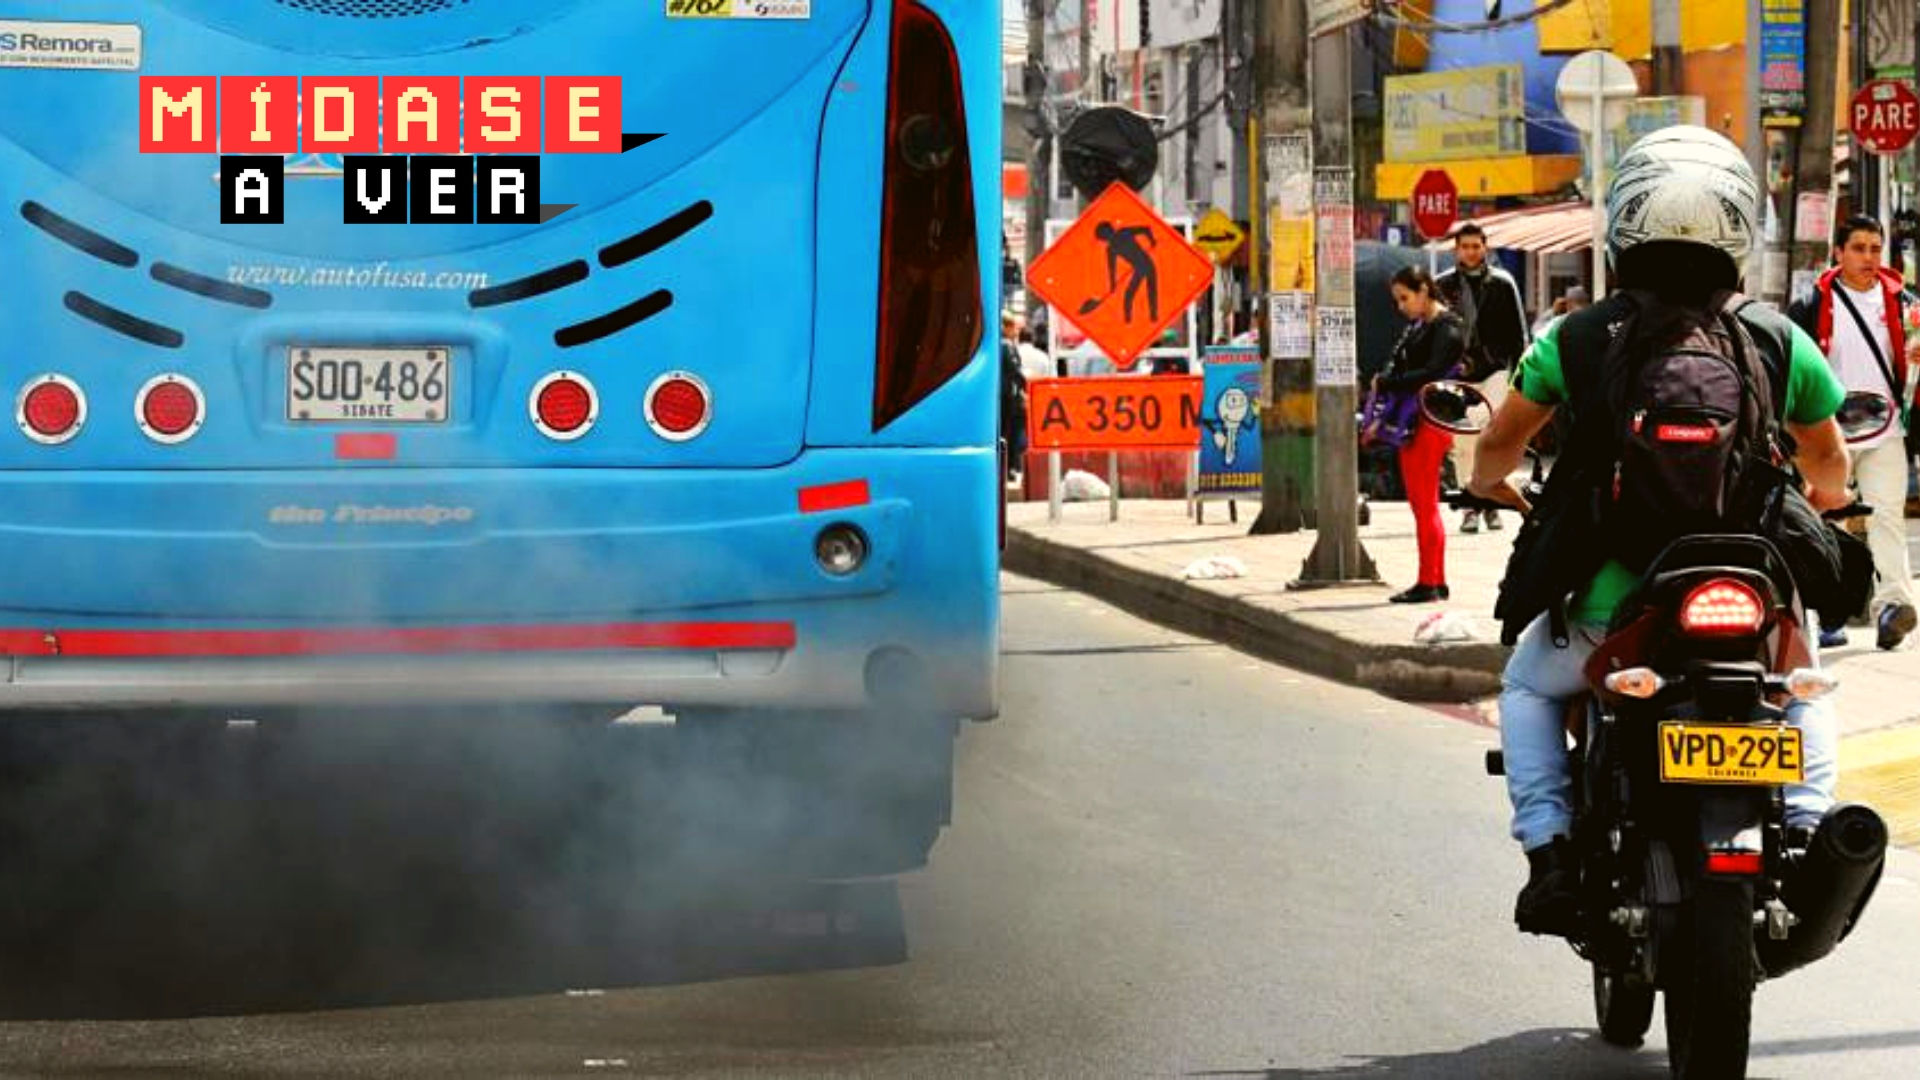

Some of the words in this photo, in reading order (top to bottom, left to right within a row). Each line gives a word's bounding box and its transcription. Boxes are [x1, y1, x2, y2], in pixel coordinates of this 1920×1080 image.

[20, 33, 113, 53] Remora
[1855, 102, 1916, 131] PARE
[1418, 192, 1450, 216] PARE
[228, 261, 490, 290] www.autofusa.com
[1041, 397, 1072, 431] A
[1087, 395, 1162, 431] 350
